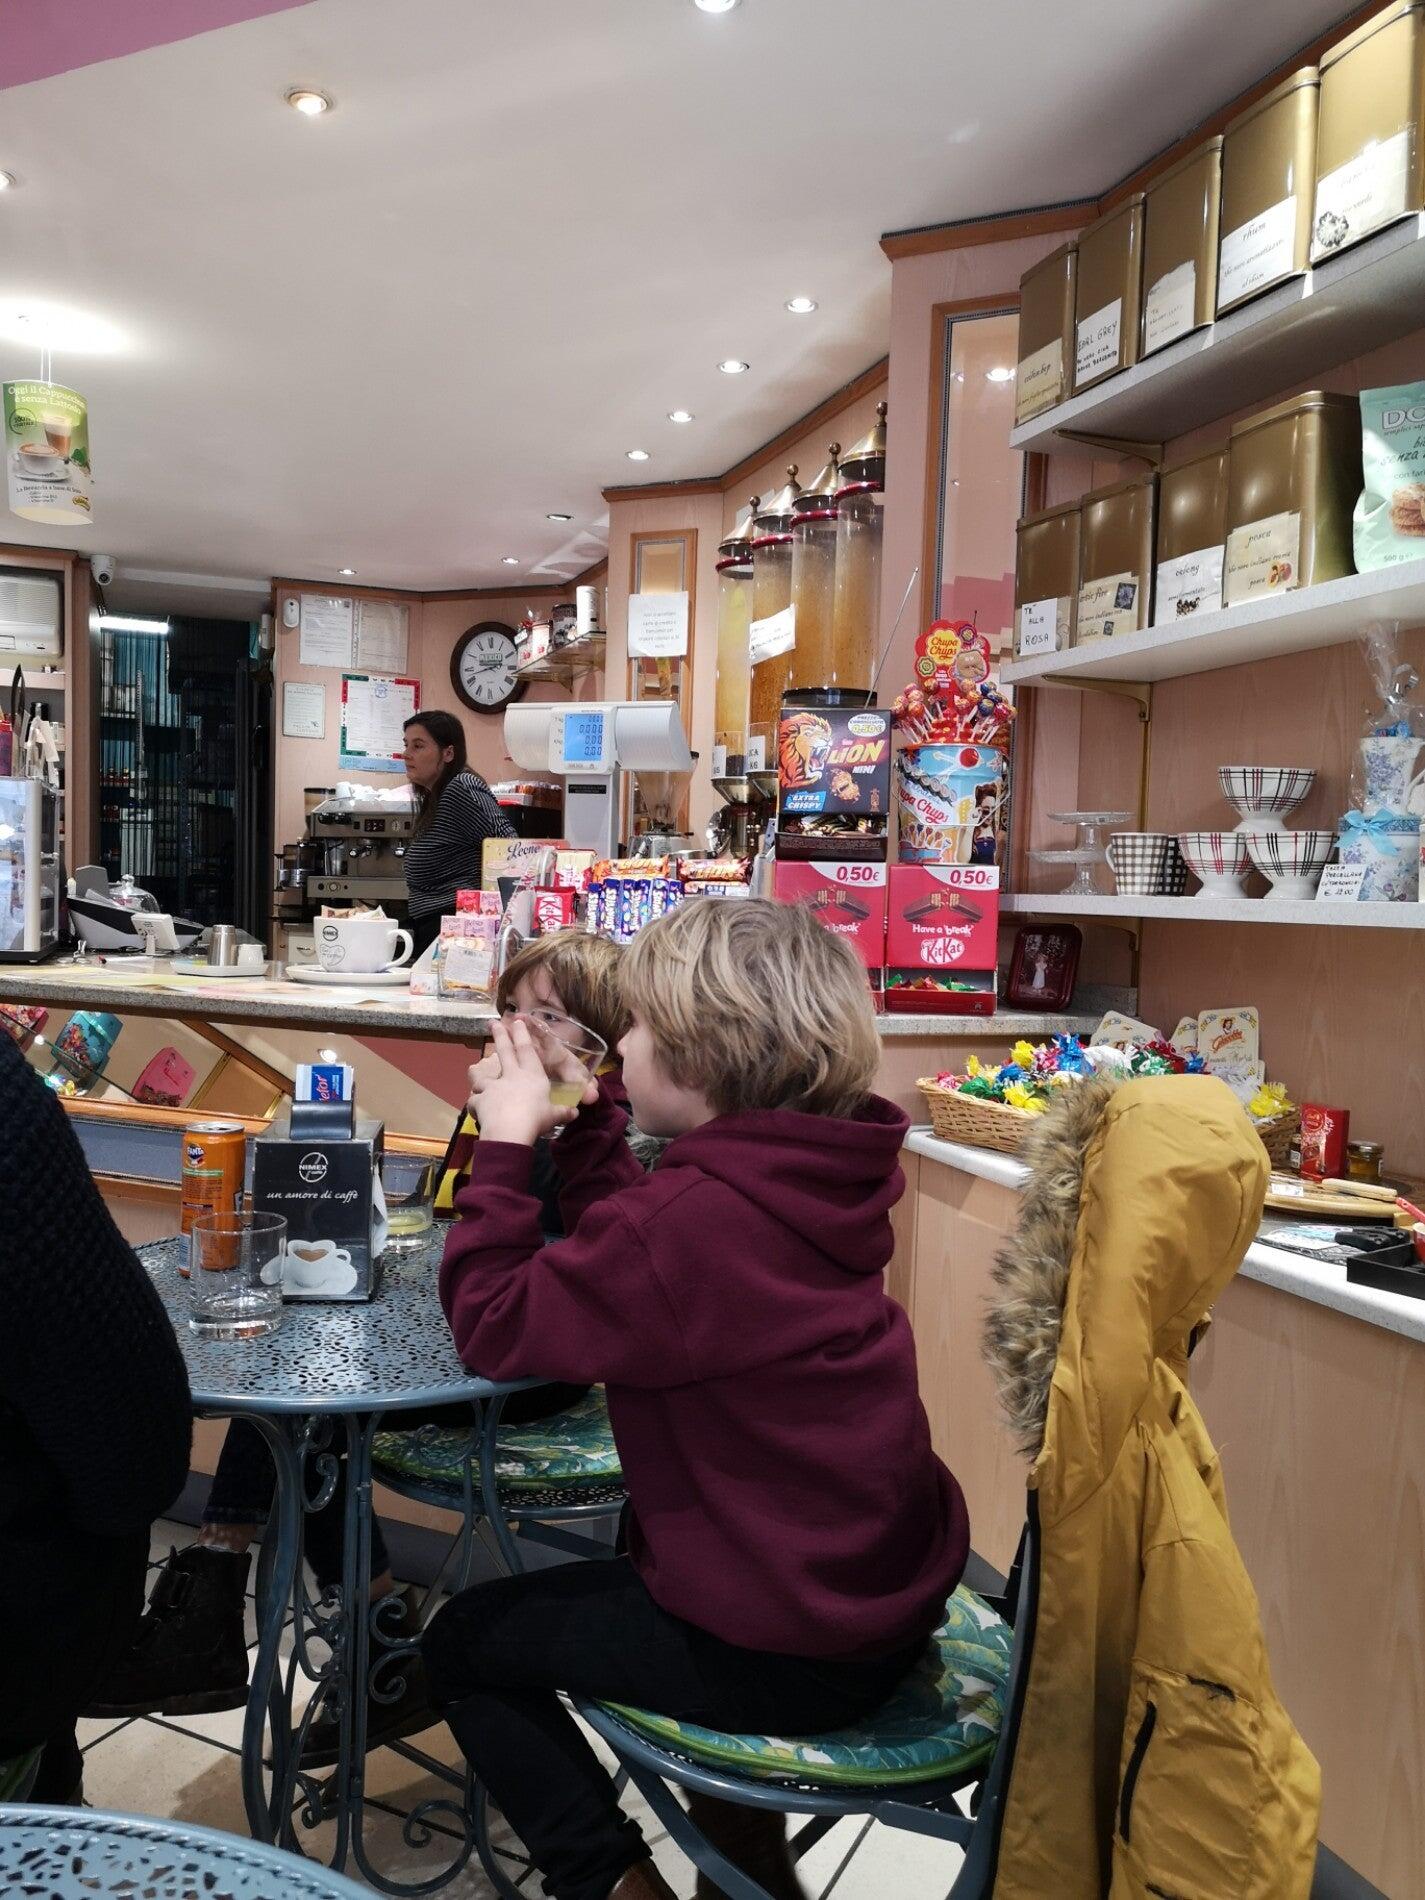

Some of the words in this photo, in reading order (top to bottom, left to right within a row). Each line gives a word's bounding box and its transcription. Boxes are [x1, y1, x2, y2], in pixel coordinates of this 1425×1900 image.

[931, 636, 958, 647] Chupa
[1025, 632, 1049, 646] ROSA
[930, 646, 957, 660] Chups
[827, 740, 886, 764] LION
[787, 802, 822, 810] CRISPY
[916, 798, 951, 824] Chups
[912, 923, 936, 934] Have
[936, 926, 944, 934] a
[922, 937, 963, 964] KitKat
[315, 1073, 331, 1102] etor
[266, 1192, 282, 1200] un
[285, 1191, 319, 1200] amore
[320, 1189, 332, 1200] di
[334, 1189, 359, 1204] caffè
